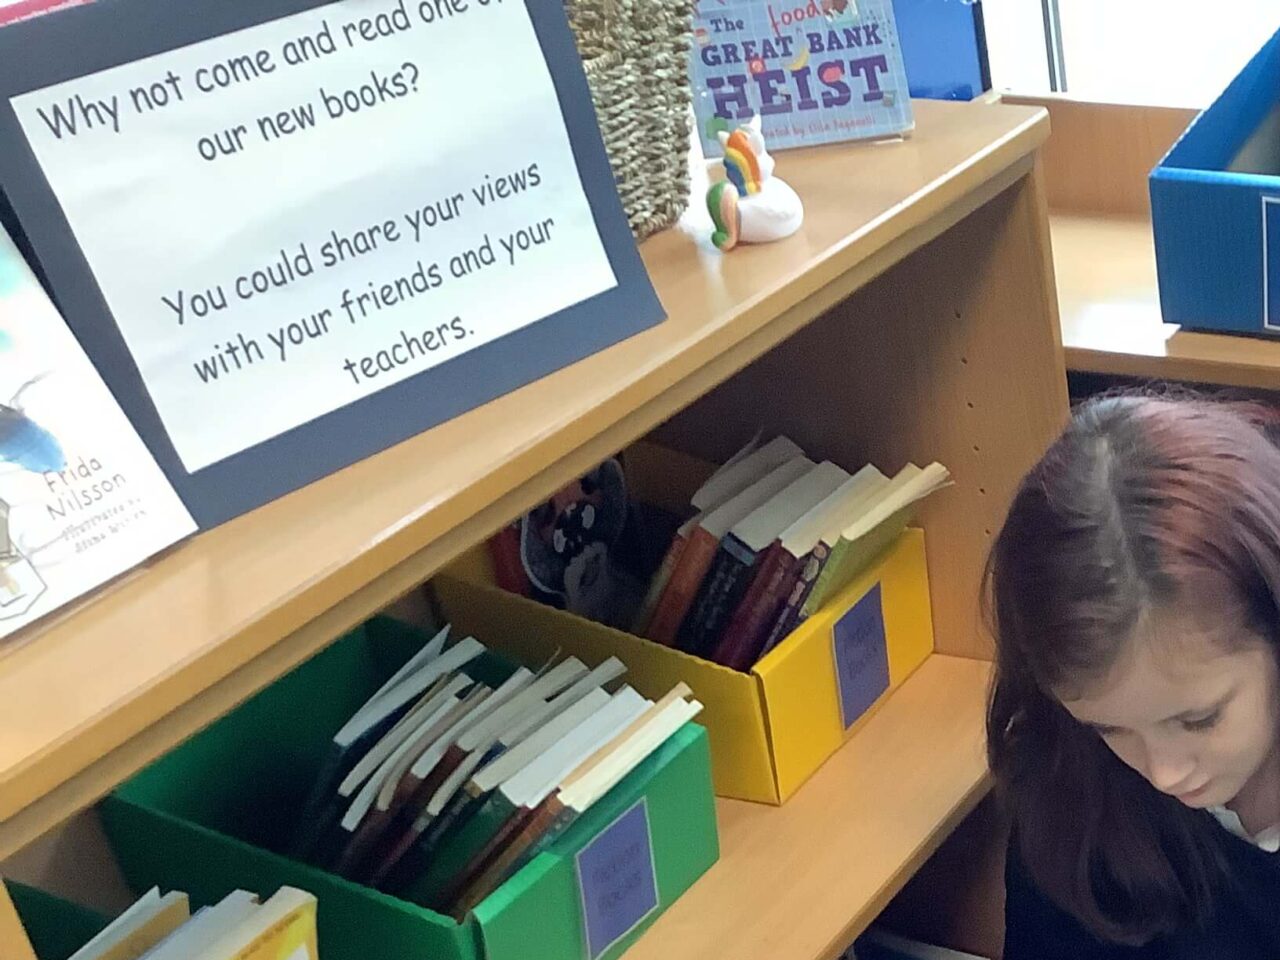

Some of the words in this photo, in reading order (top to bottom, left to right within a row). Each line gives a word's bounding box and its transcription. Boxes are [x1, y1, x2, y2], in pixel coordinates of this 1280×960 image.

[701, 34, 794, 67] GREAT
[806, 24, 884, 54] BANK
[710, 17, 745, 33] The
[36, 94, 120, 140] Why
[129, 70, 184, 114] not
[195, 49, 277, 94] come
[282, 19, 338, 66] and
[341, 0, 412, 48] read
[418, 0, 469, 24] one
[707, 53, 889, 120] HEIST
[197, 124, 248, 162] our
[256, 102, 316, 142] new
[318, 61, 420, 120] books?
[160, 285, 228, 326] You
[235, 241, 315, 300] could
[320, 220, 401, 268] share
[403, 192, 465, 244] your
[471, 162, 542, 207] views
[193, 332, 265, 384] with
[266, 308, 333, 363] your
[340, 260, 443, 325] friends
[449, 233, 497, 279] and
[498, 217, 555, 267] your
[342, 315, 475, 385] teachers.
[42, 455, 103, 493] Frida
[45, 473, 127, 521] Nilsson
